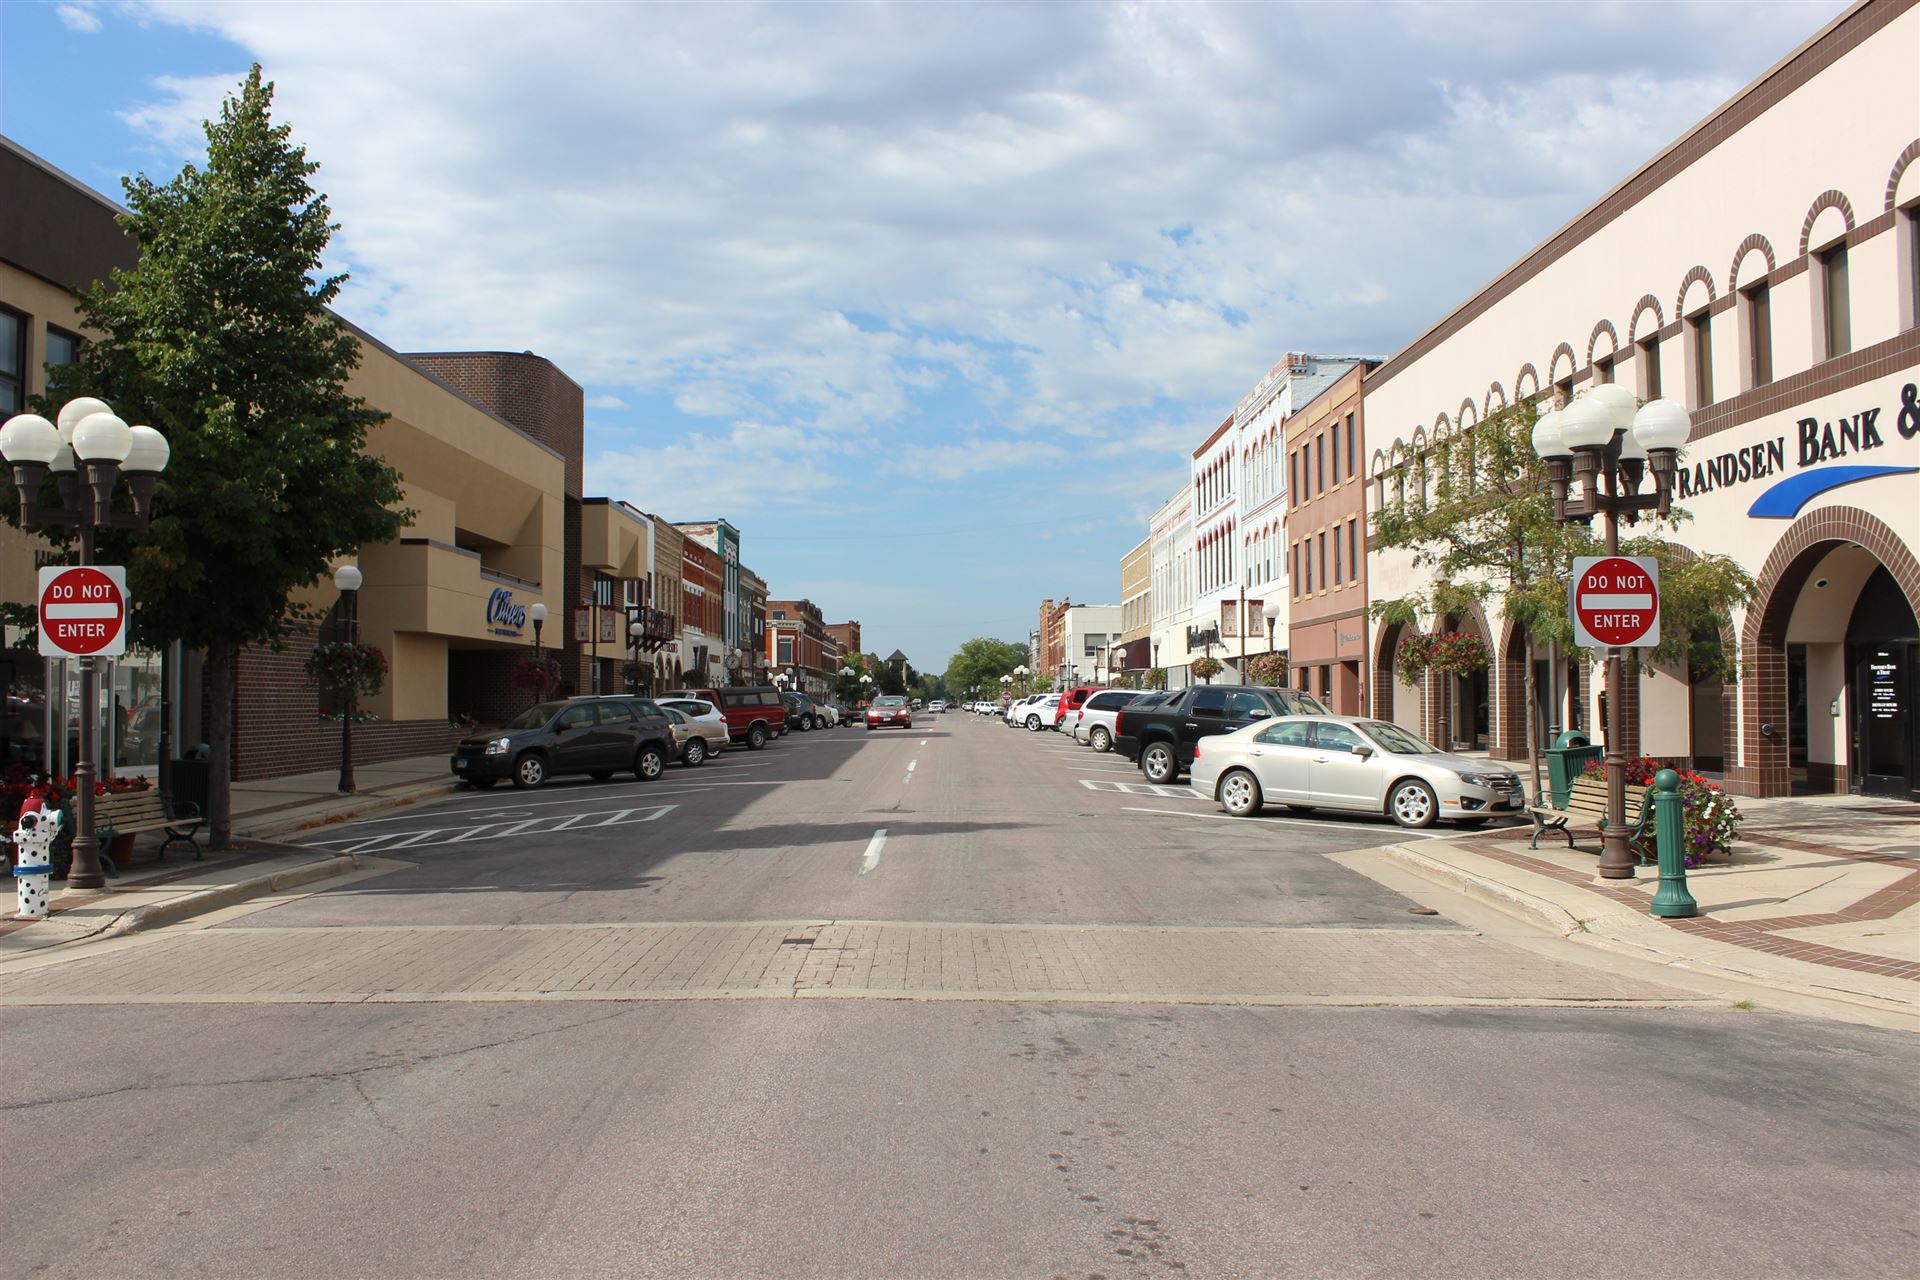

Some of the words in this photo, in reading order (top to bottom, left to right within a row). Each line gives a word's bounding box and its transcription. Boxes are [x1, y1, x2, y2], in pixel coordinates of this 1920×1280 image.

[1797, 407, 1884, 467] BANK
[1897, 383, 1920, 440] &
[1587, 575, 1608, 589] DO
[1616, 575, 1645, 589] NOT
[53, 585, 73, 598] DO
[82, 585, 111, 598] NOT
[1594, 614, 1640, 628] ENTER
[58, 623, 105, 637] ENTER
